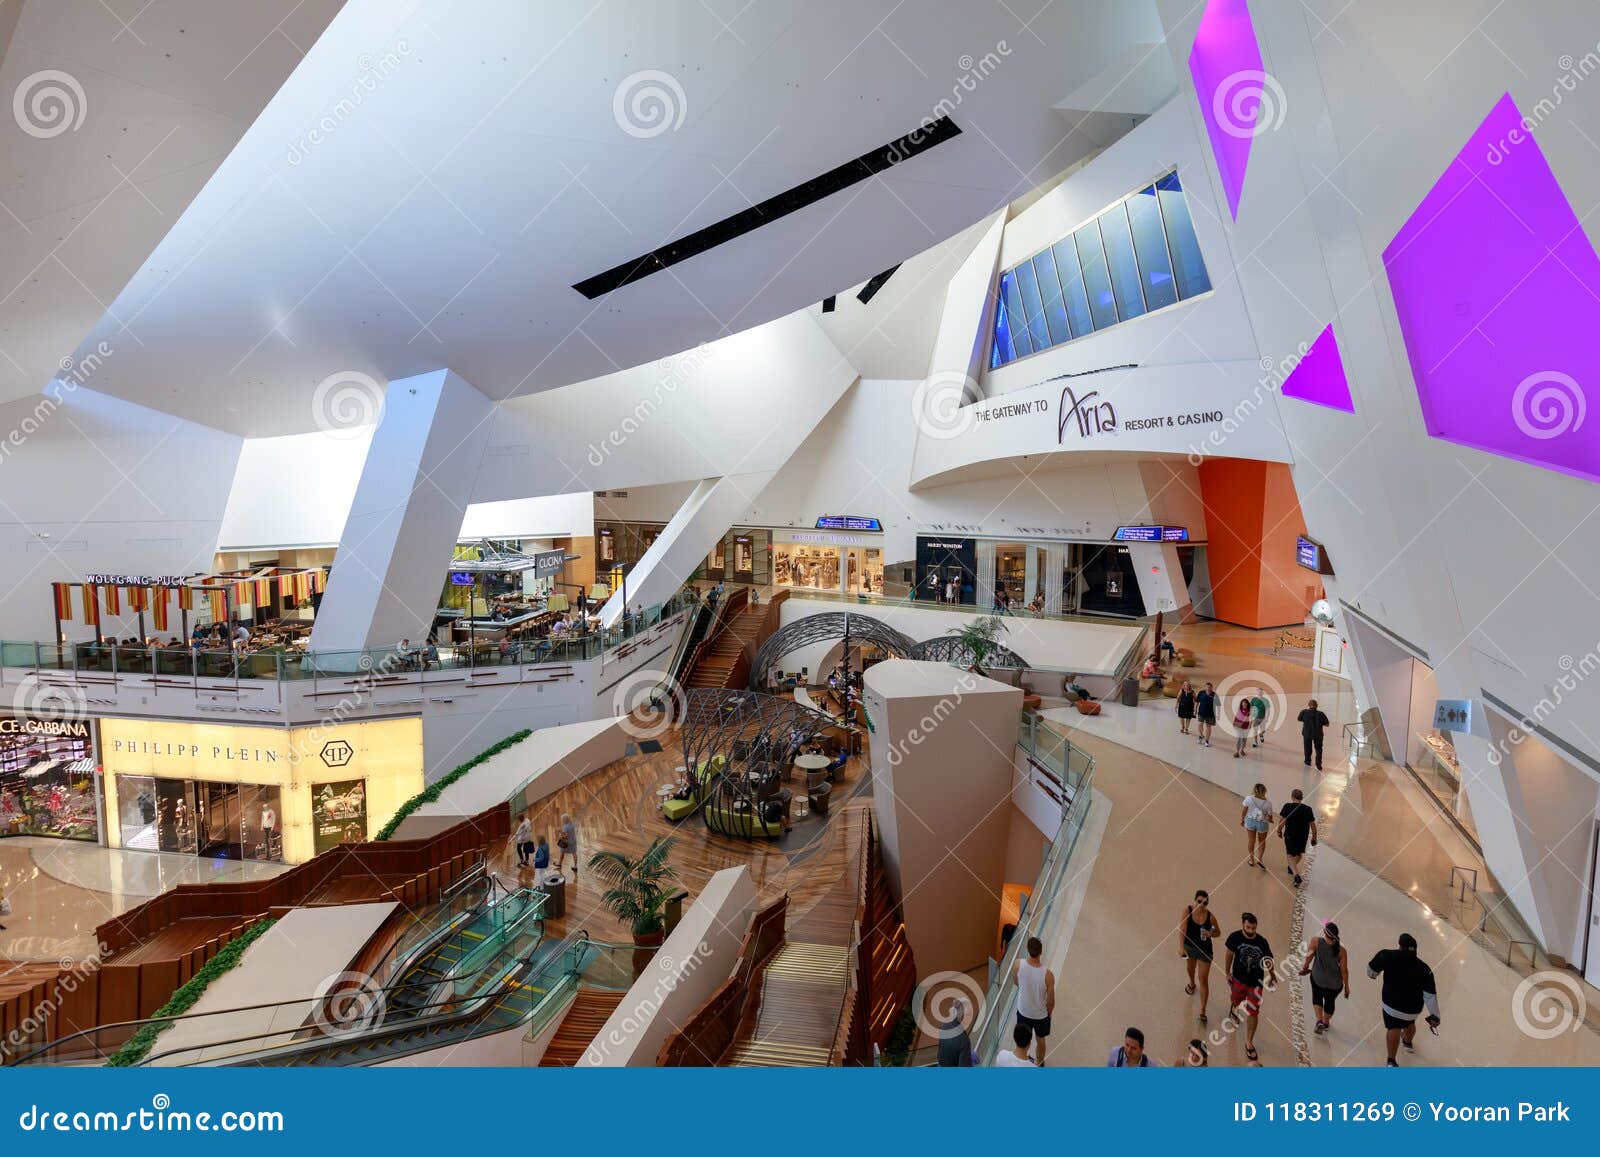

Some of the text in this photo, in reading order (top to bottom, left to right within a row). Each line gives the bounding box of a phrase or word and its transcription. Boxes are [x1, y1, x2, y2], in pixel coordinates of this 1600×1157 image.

[975, 386, 1223, 445] THE GATEWAY TO Aria RESORT & CASINO
[539, 555, 563, 569] CUCINA
[86, 575, 186, 586] WOLFGANG PUCK
[114, 740, 277, 763] PHILIPP PLEIN
